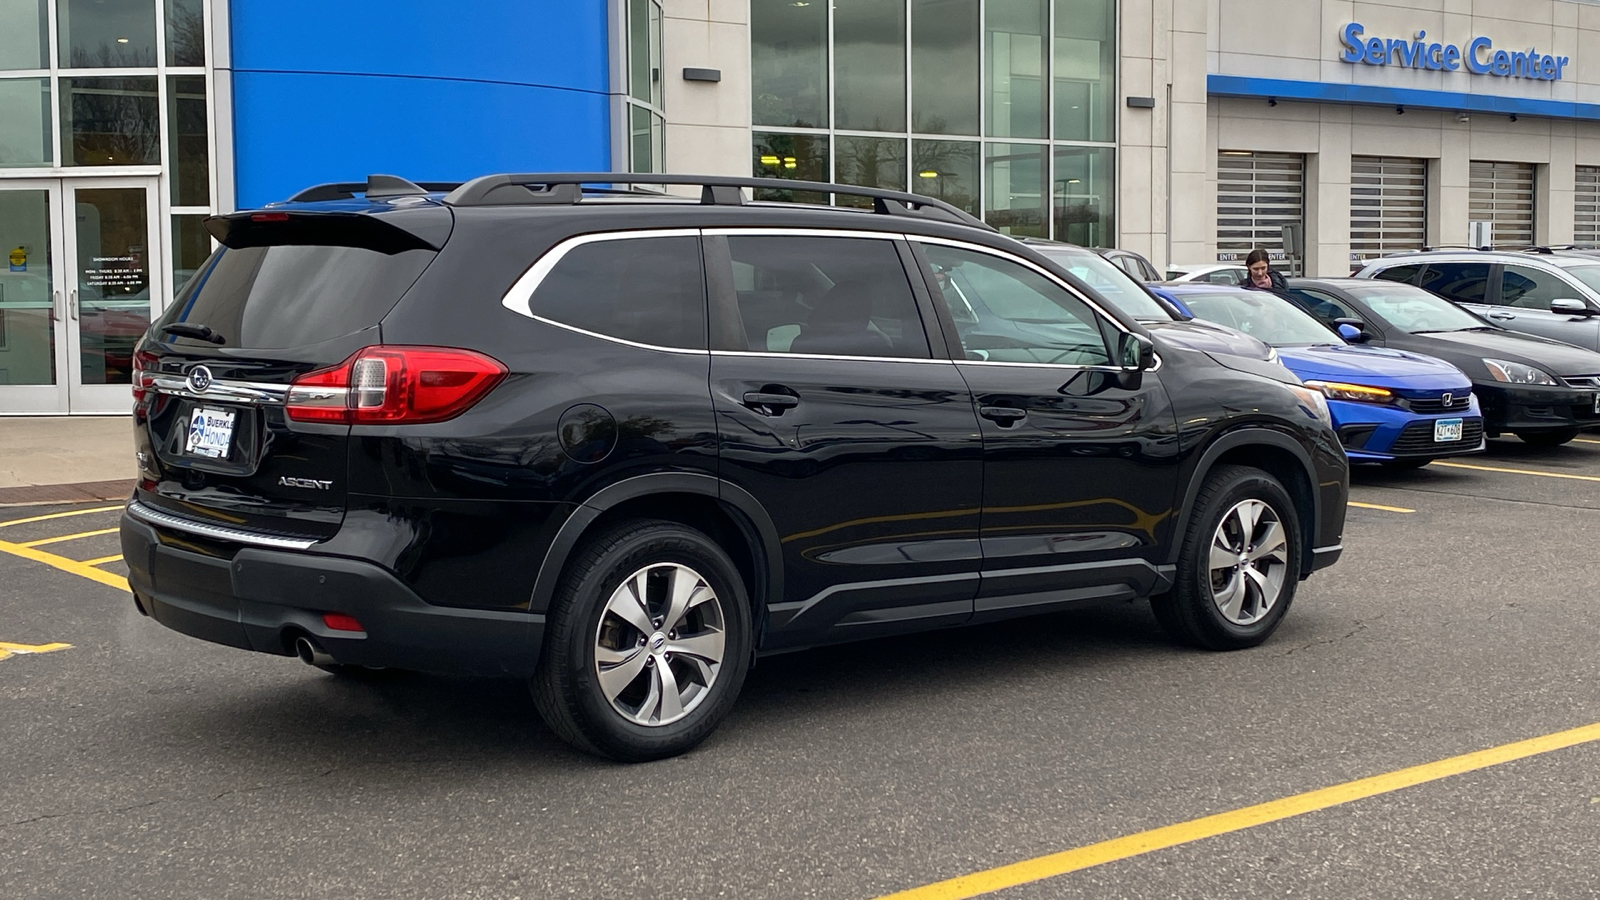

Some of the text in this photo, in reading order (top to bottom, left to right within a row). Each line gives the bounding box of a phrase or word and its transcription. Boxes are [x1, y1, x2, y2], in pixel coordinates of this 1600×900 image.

[1339, 22, 1569, 80] Service Center
[206, 416, 234, 430] BUERKLE
[203, 427, 231, 446] HONDA
[277, 476, 334, 490] ASCENT
